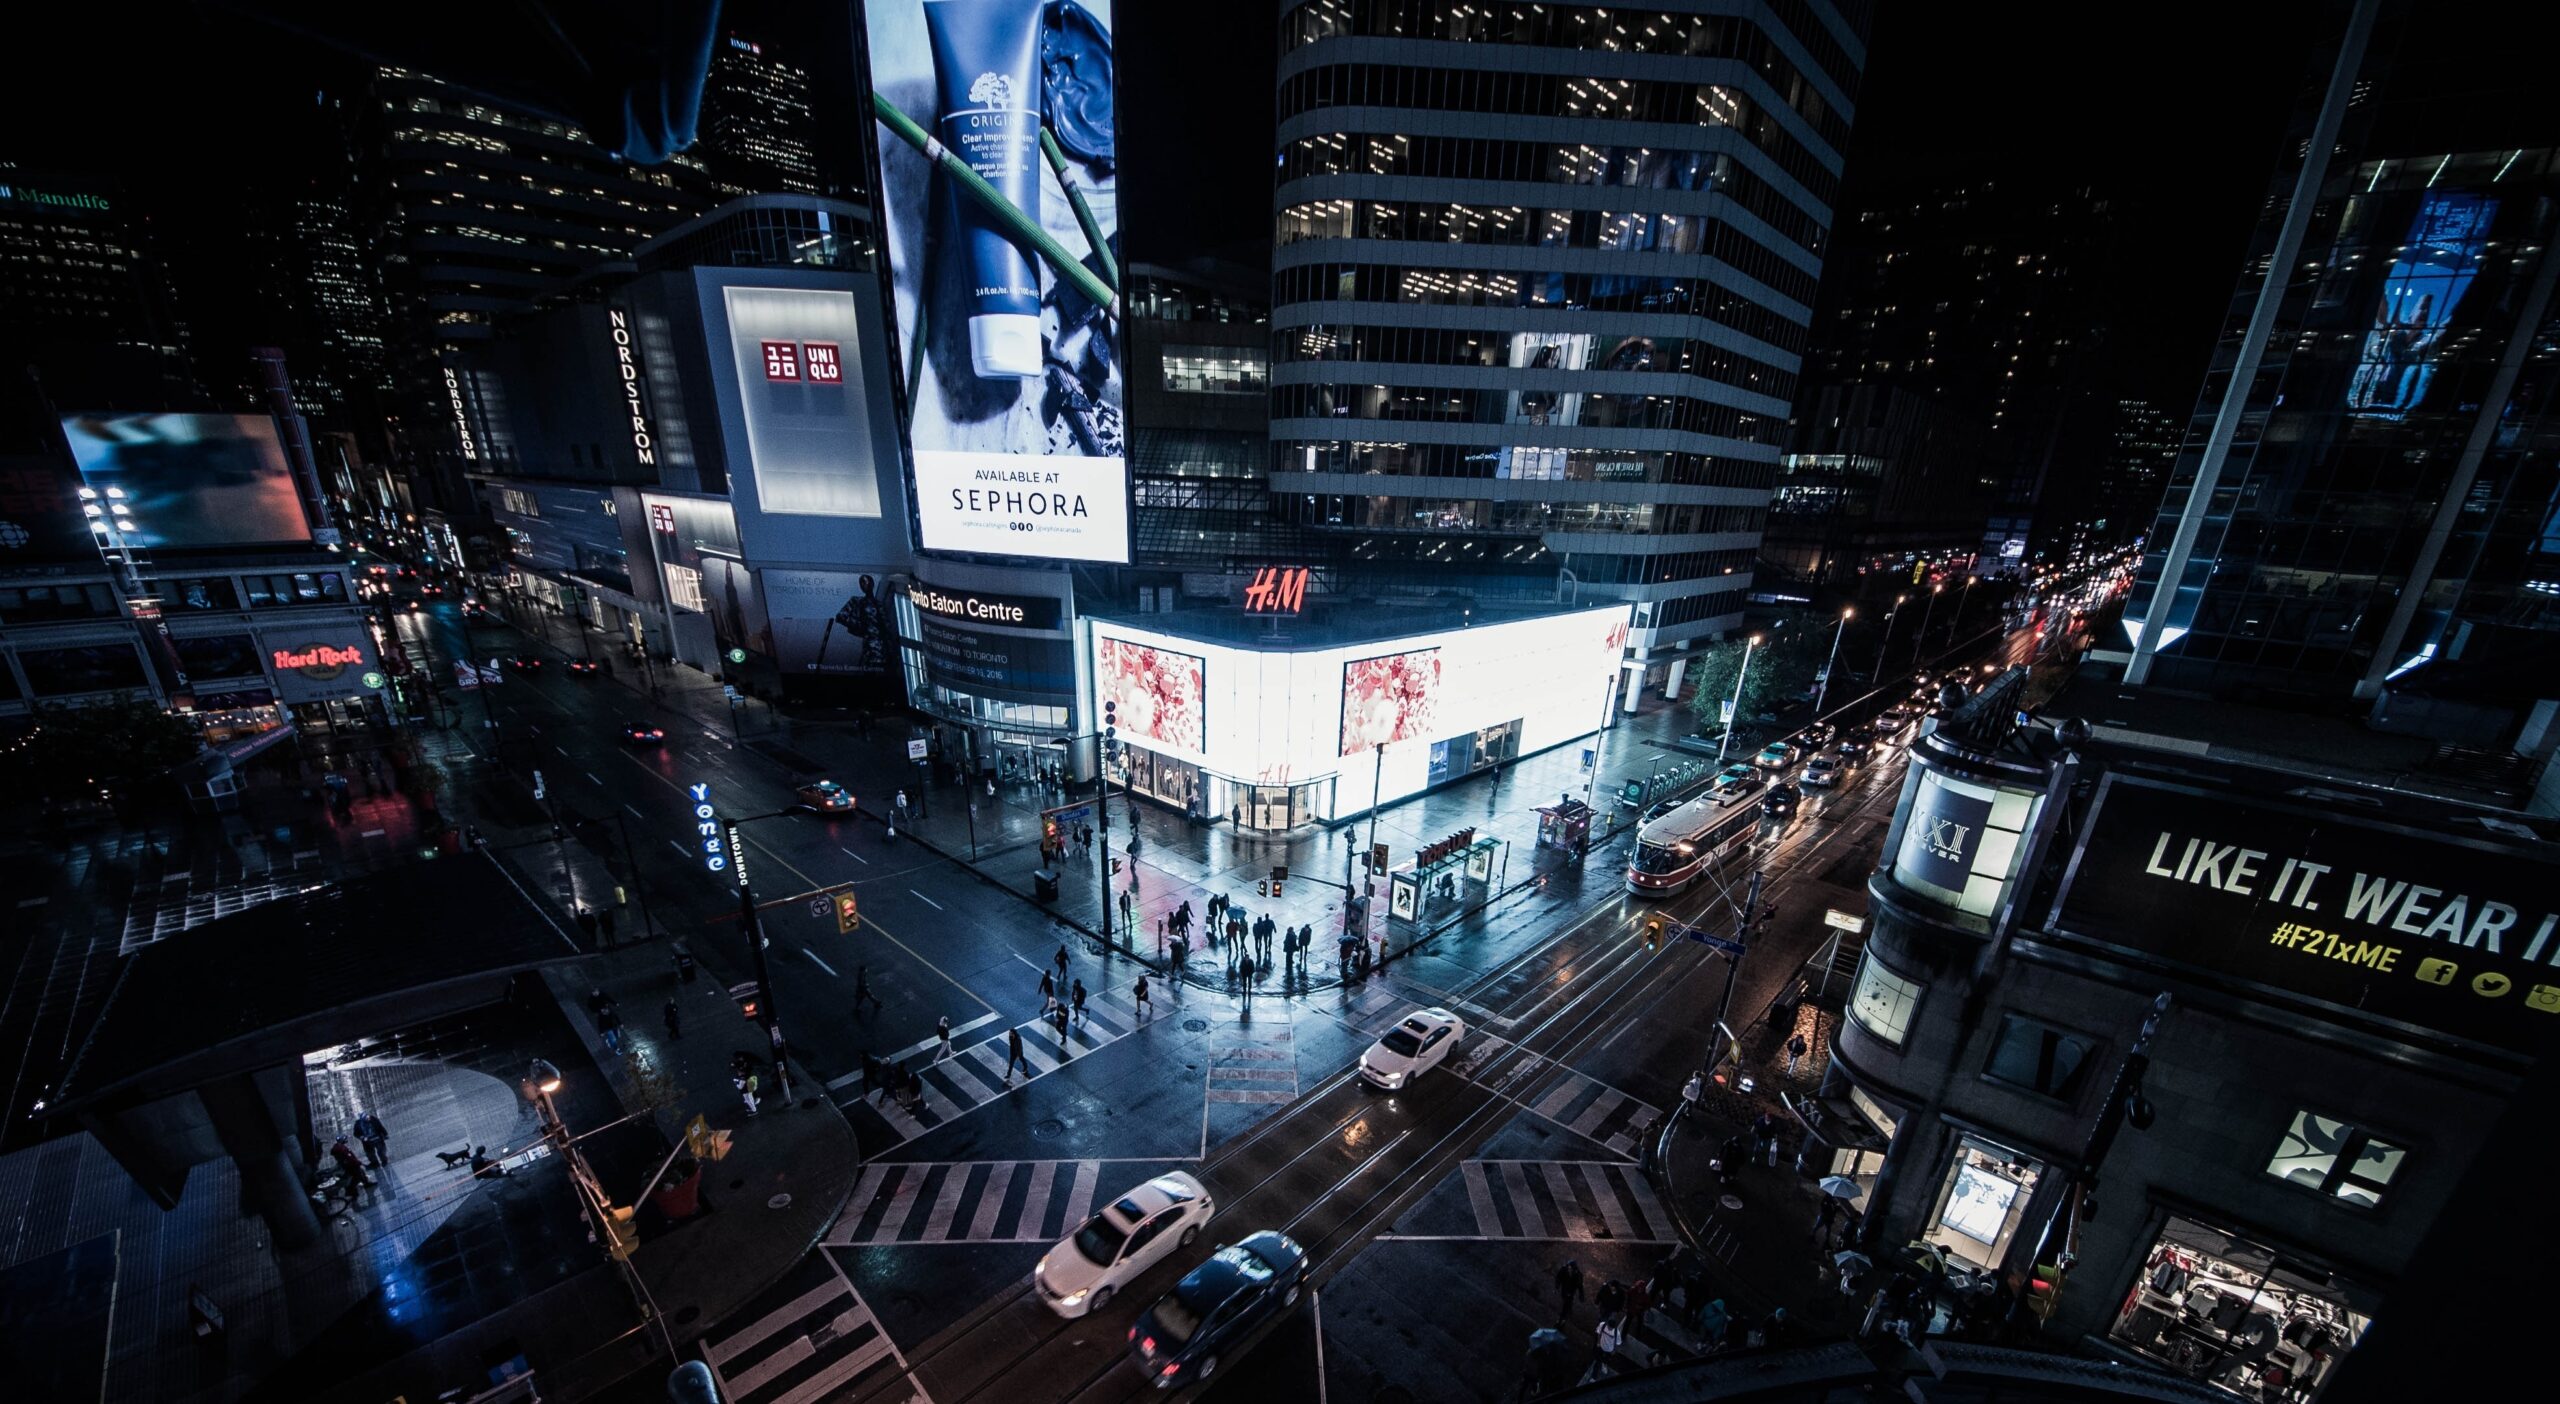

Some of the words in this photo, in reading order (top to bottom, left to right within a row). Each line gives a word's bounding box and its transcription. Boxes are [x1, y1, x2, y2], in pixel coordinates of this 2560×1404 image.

[16, 187, 110, 210] Manulife
[807, 347, 834, 363] UNI
[810, 363, 838, 380] QLO
[609, 310, 655, 465] NORDSTROM
[444, 368, 477, 460] NORDSTROM
[975, 470, 1040, 482] AVAILABLE
[1045, 472, 1060, 484] AT
[952, 488, 1088, 518] SEPHORA
[769, 585, 813, 595] TORONTO
[816, 587, 842, 596] STYLE
[1245, 567, 1308, 613] H&M
[930, 592, 963, 615] Eaton
[967, 599, 1024, 621] Centre
[273, 648, 318, 669] Hard
[318, 645, 363, 666] Rock
[972, 650, 1008, 664] TORONTO
[986, 669, 1003, 680] 2016
[690, 782, 726, 871] Yonge
[728, 827, 748, 886] DOWNTOWN
[2146, 831, 2268, 895] LIKE
[2269, 858, 2332, 911] IT.
[2344, 872, 2518, 955] WEAR
[2521, 912, 2560, 968] I
[1703, 935, 1727, 948] Yonge
[2270, 921, 2402, 974] #F21xME
